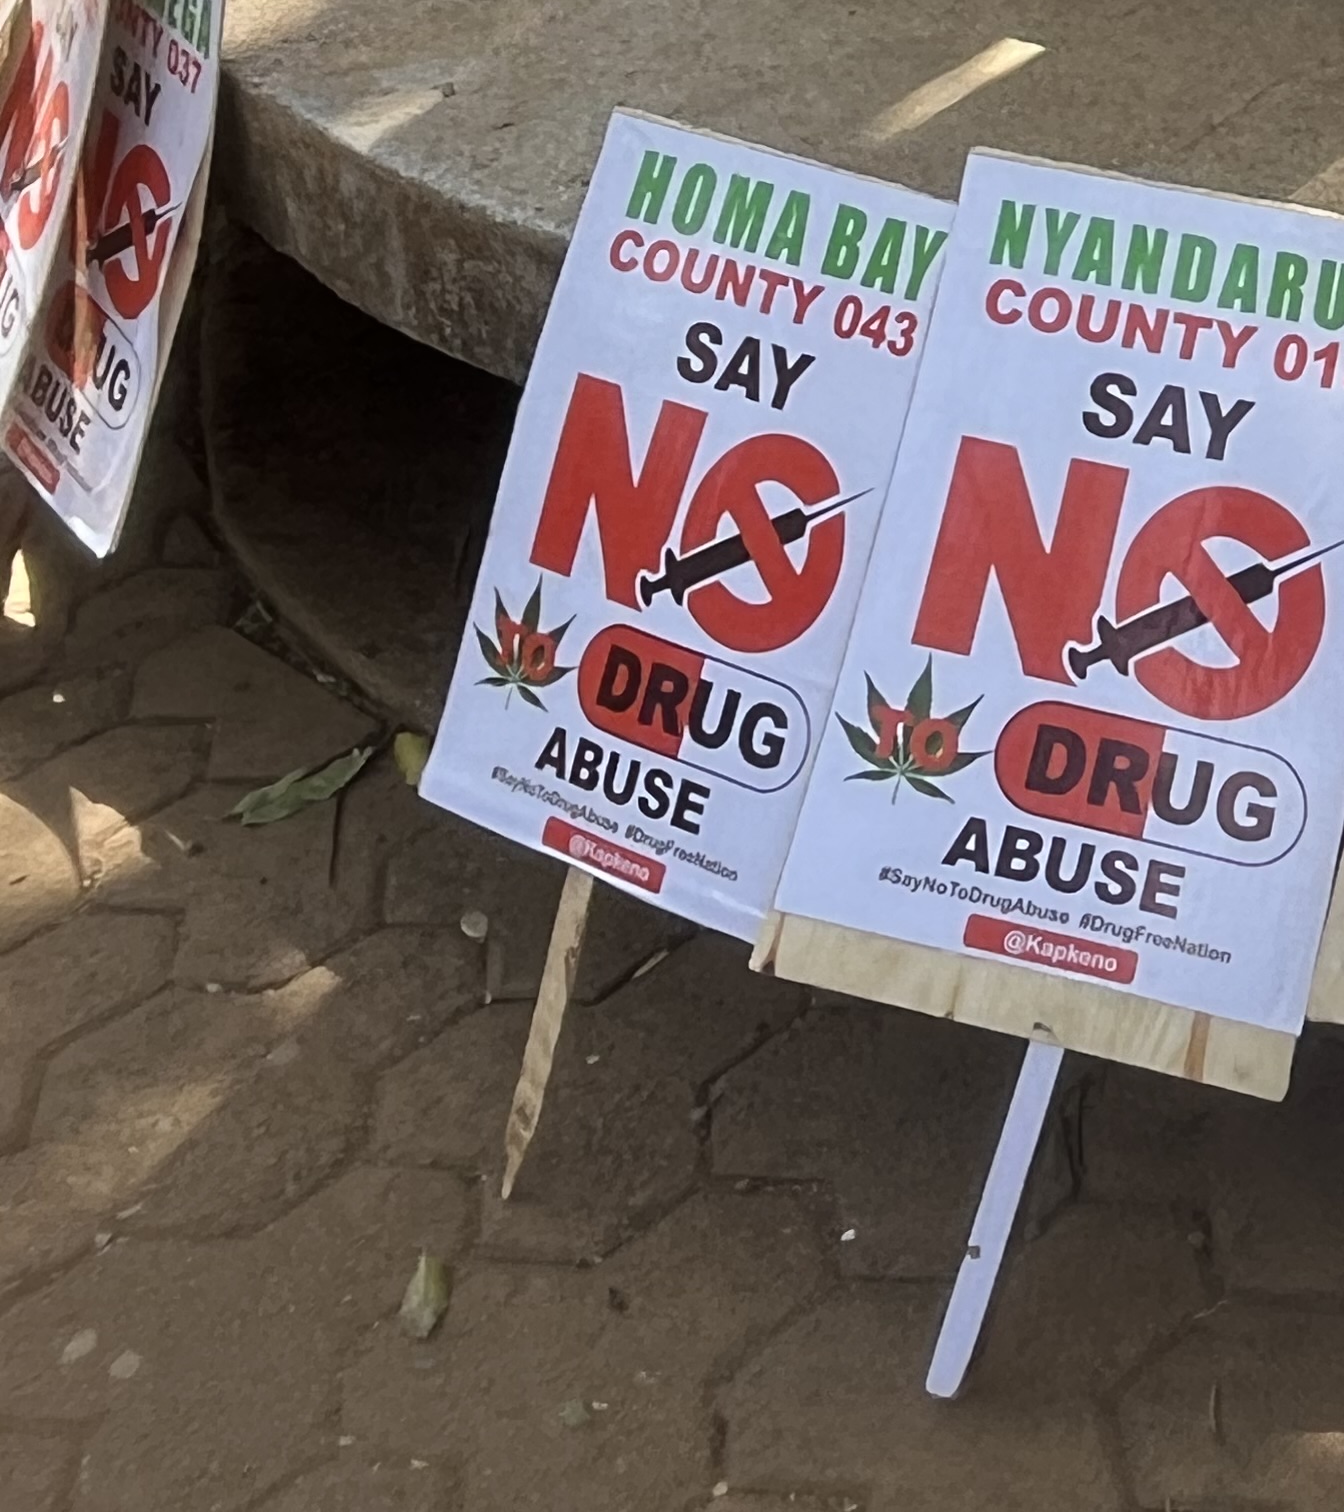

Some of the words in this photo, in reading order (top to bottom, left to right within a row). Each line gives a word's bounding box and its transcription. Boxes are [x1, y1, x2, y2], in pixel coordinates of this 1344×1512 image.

[110, 47, 161, 126] SAY
[167, 40, 202, 93] 037
[626, 150, 810, 269] HOMA
[822, 202, 948, 302] BAY
[609, 229, 825, 326] COUNTY
[833, 293, 918, 357] 043
[984, 278, 1260, 369] COUNTY
[16, 354, 92, 456] ABUSE
[676, 321, 816, 412] SAY
[1082, 372, 1255, 462] SAY
[530, 372, 845, 654] NO
[912, 434, 1325, 722] NO
[496, 614, 558, 681] TO
[596, 643, 787, 770] DRUG
[535, 727, 711, 835] ABUSE
[871, 702, 962, 773] TO
[1024, 726, 1277, 842] DRUG
[878, 866, 1070, 925] #SayNoToDrugAbuse
[1079, 913, 1232, 965] #DrugFreeNation
[941, 817, 1187, 919] ABUSE
